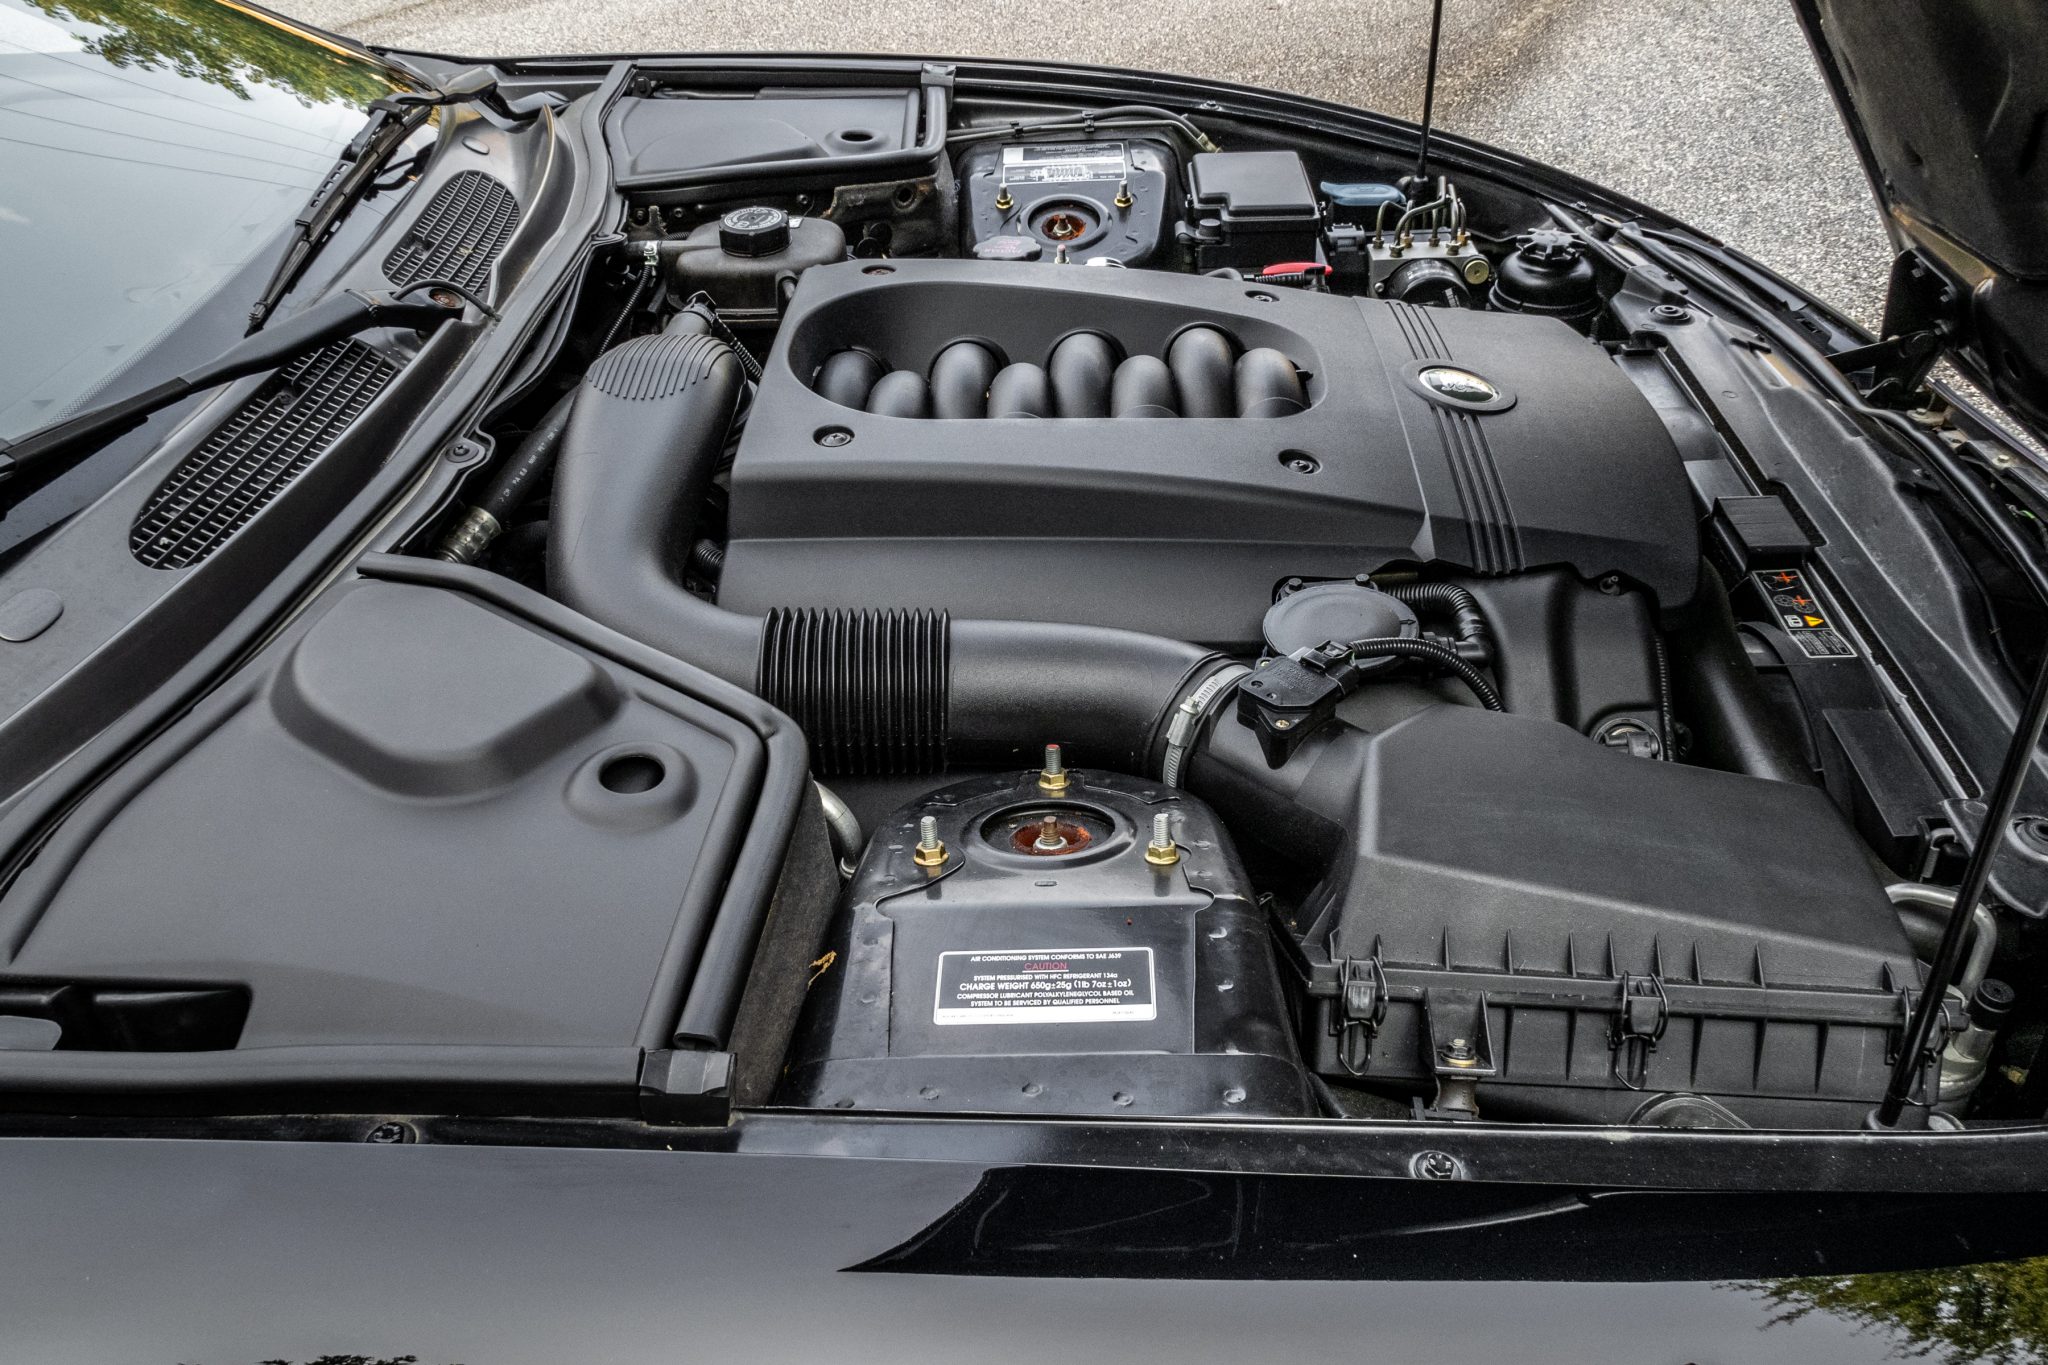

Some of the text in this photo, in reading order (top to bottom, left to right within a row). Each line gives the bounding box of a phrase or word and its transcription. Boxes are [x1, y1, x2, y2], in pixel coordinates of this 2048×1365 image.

[1024, 962, 1067, 970] CAUTION
[960, 983, 995, 991] CHARGE
[997, 982, 1029, 990] WEIGHT
